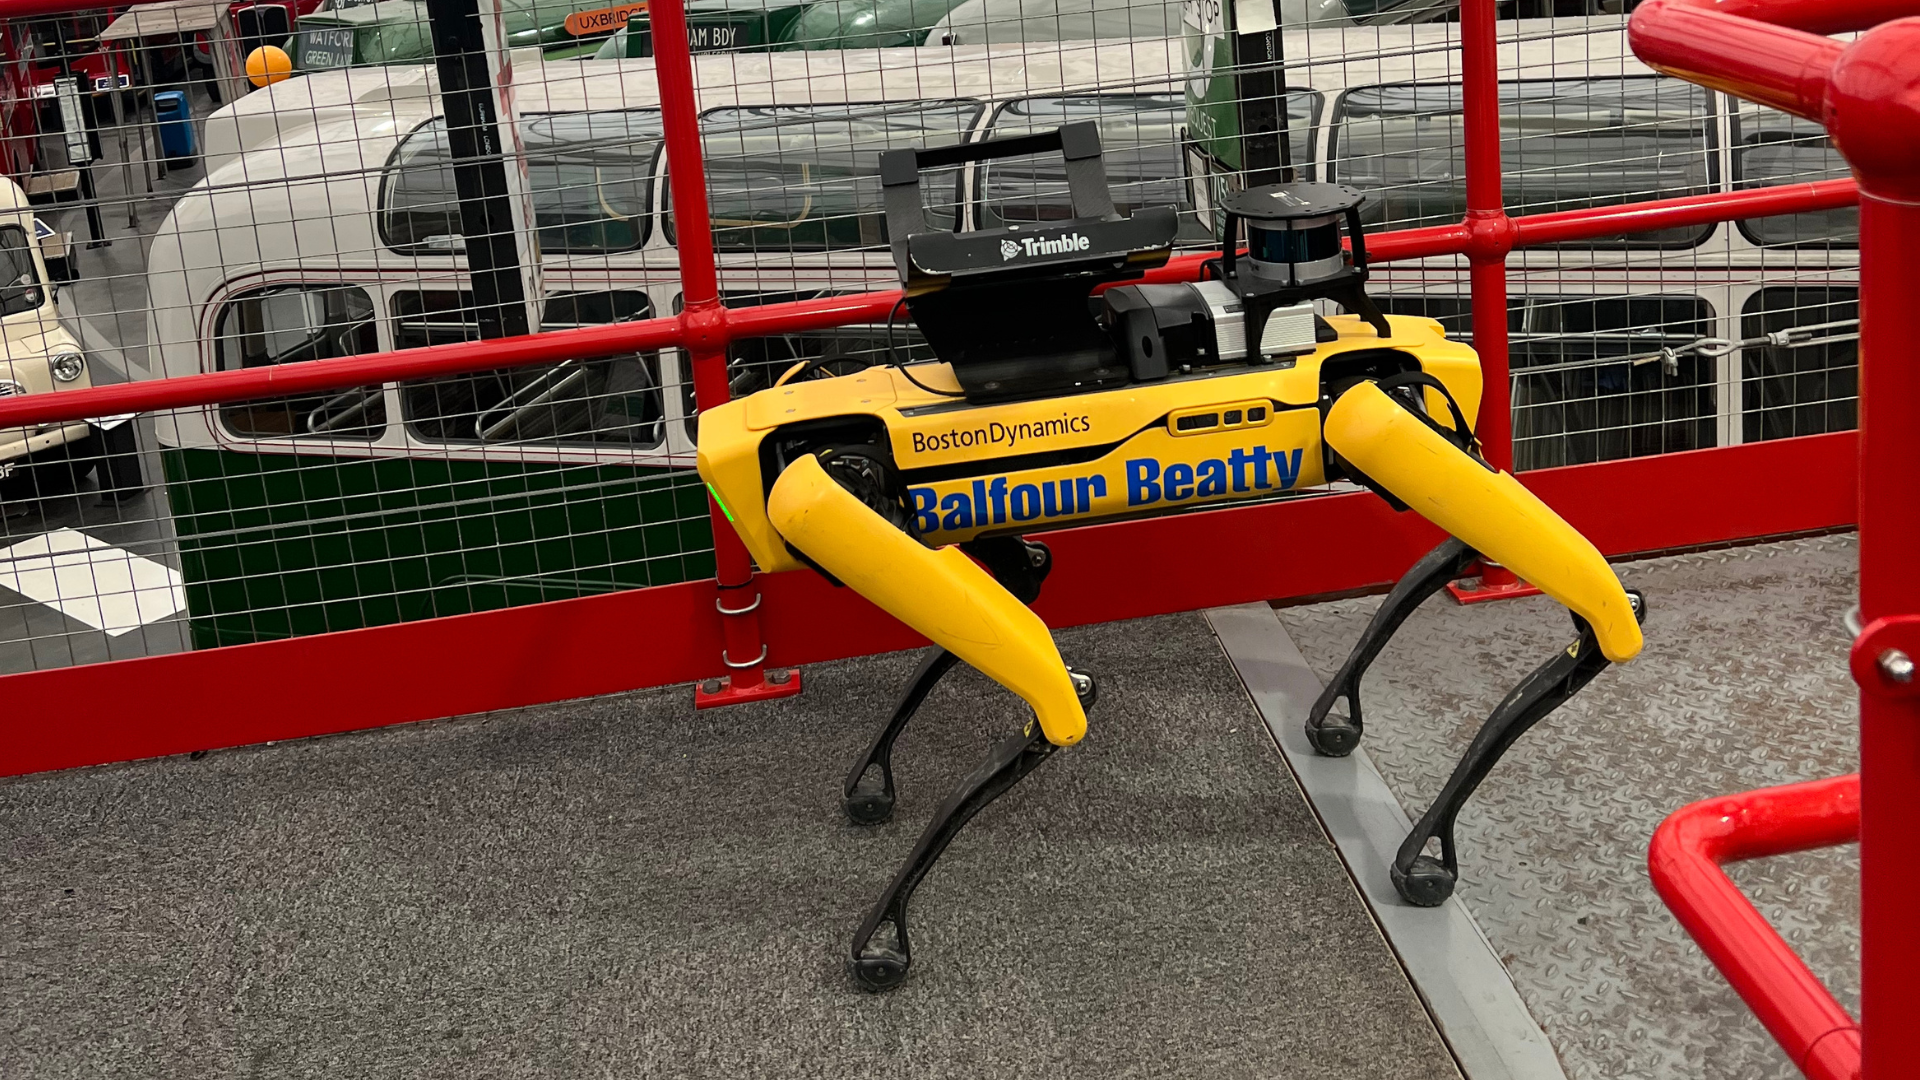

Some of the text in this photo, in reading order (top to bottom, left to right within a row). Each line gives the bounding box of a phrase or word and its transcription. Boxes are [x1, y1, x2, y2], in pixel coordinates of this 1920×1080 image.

[713, 27, 737, 46] BDY
[305, 50, 334, 66] GREEN
[1021, 233, 1090, 257] Trimble
[909, 446, 1304, 534] Balfour Beatty
